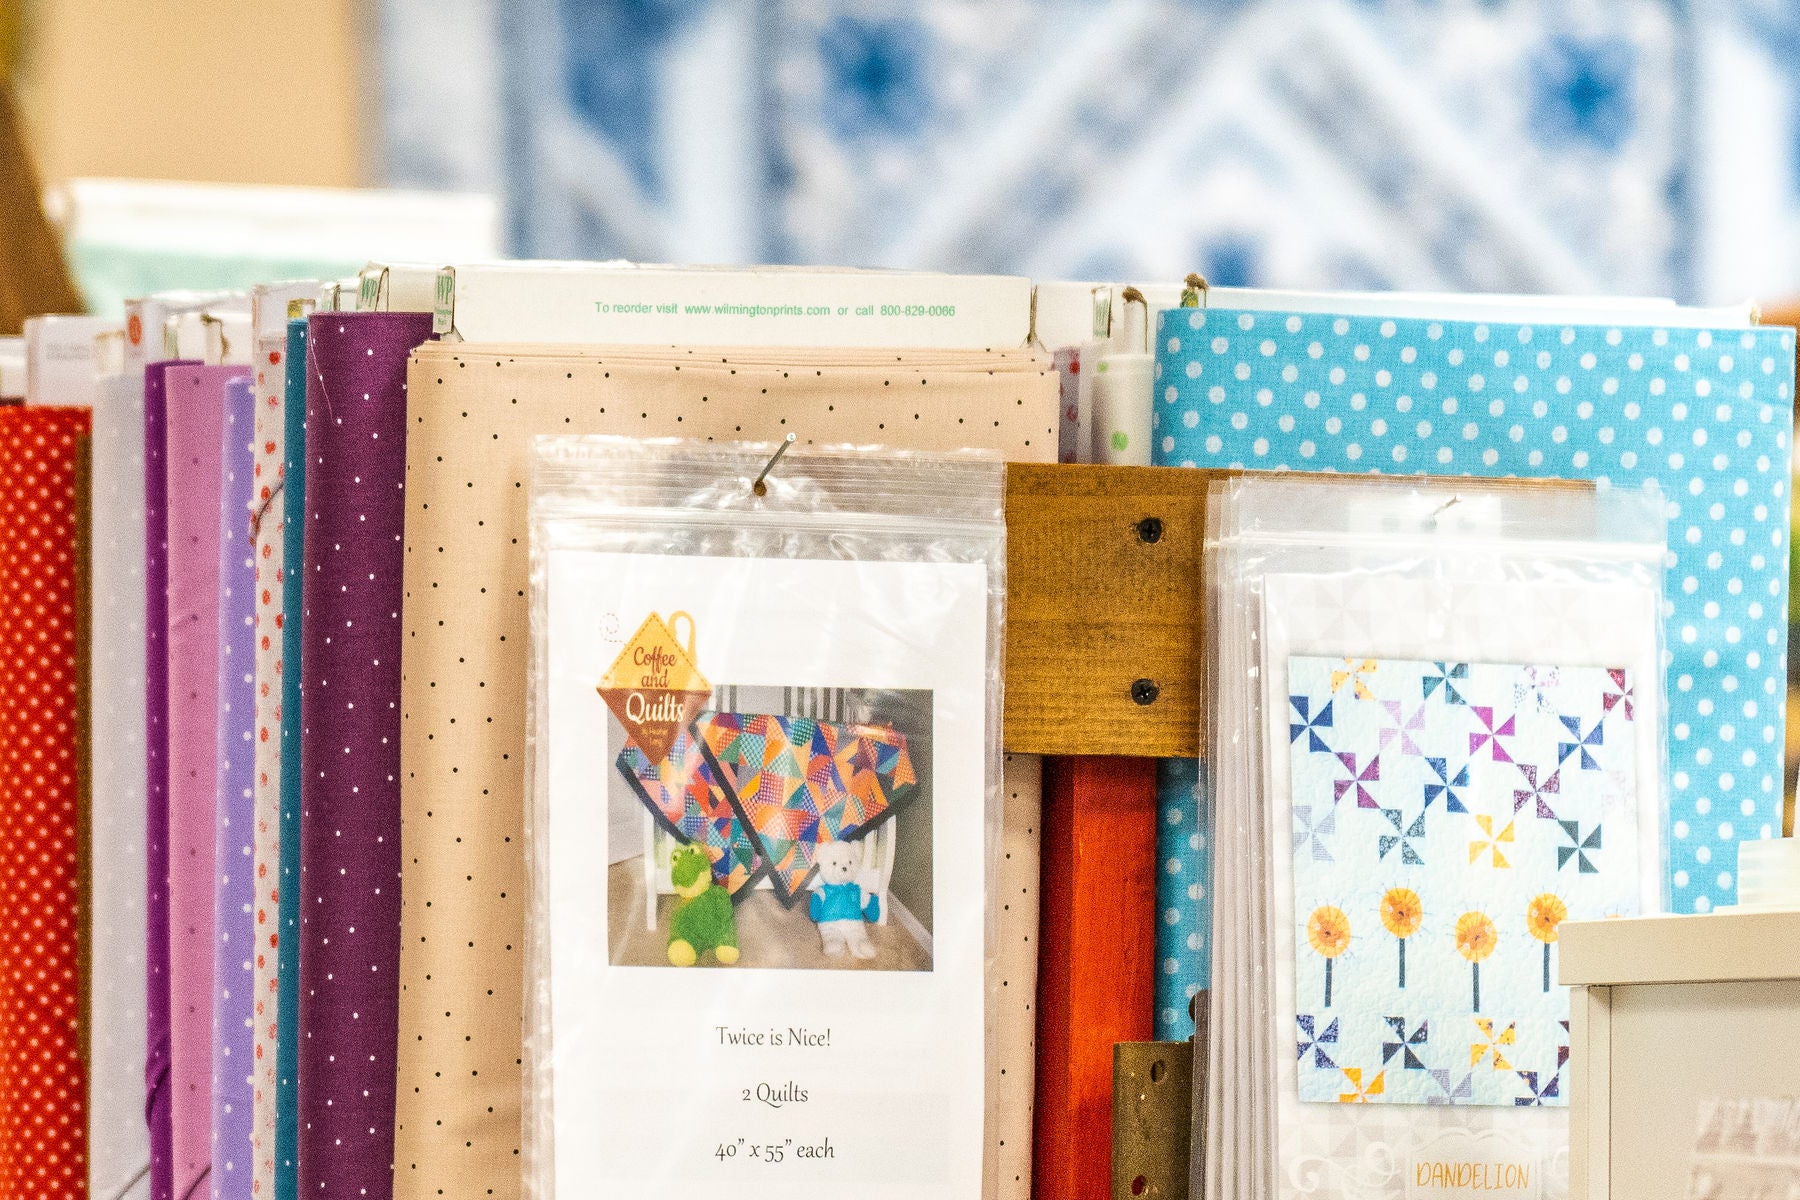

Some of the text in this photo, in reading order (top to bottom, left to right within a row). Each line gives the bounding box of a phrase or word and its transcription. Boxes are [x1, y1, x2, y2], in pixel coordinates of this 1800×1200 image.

[595, 302, 610, 313] To
[613, 302, 653, 314] reorder
[656, 303, 678, 314] visit
[684, 303, 831, 319] www.wilmingtonprints.com
[837, 306, 849, 316] or
[855, 304, 874, 316] call
[633, 645, 677, 674] Coffee
[641, 668, 671, 689] and
[625, 691, 685, 725] Quilts
[715, 1026, 832, 1047] Twice is Nice!
[741, 1080, 810, 1109] 2 Quilts
[749, 1144, 761, 1158] x
[796, 1137, 836, 1160] each
[1416, 1161, 1530, 1191] DANDELION
